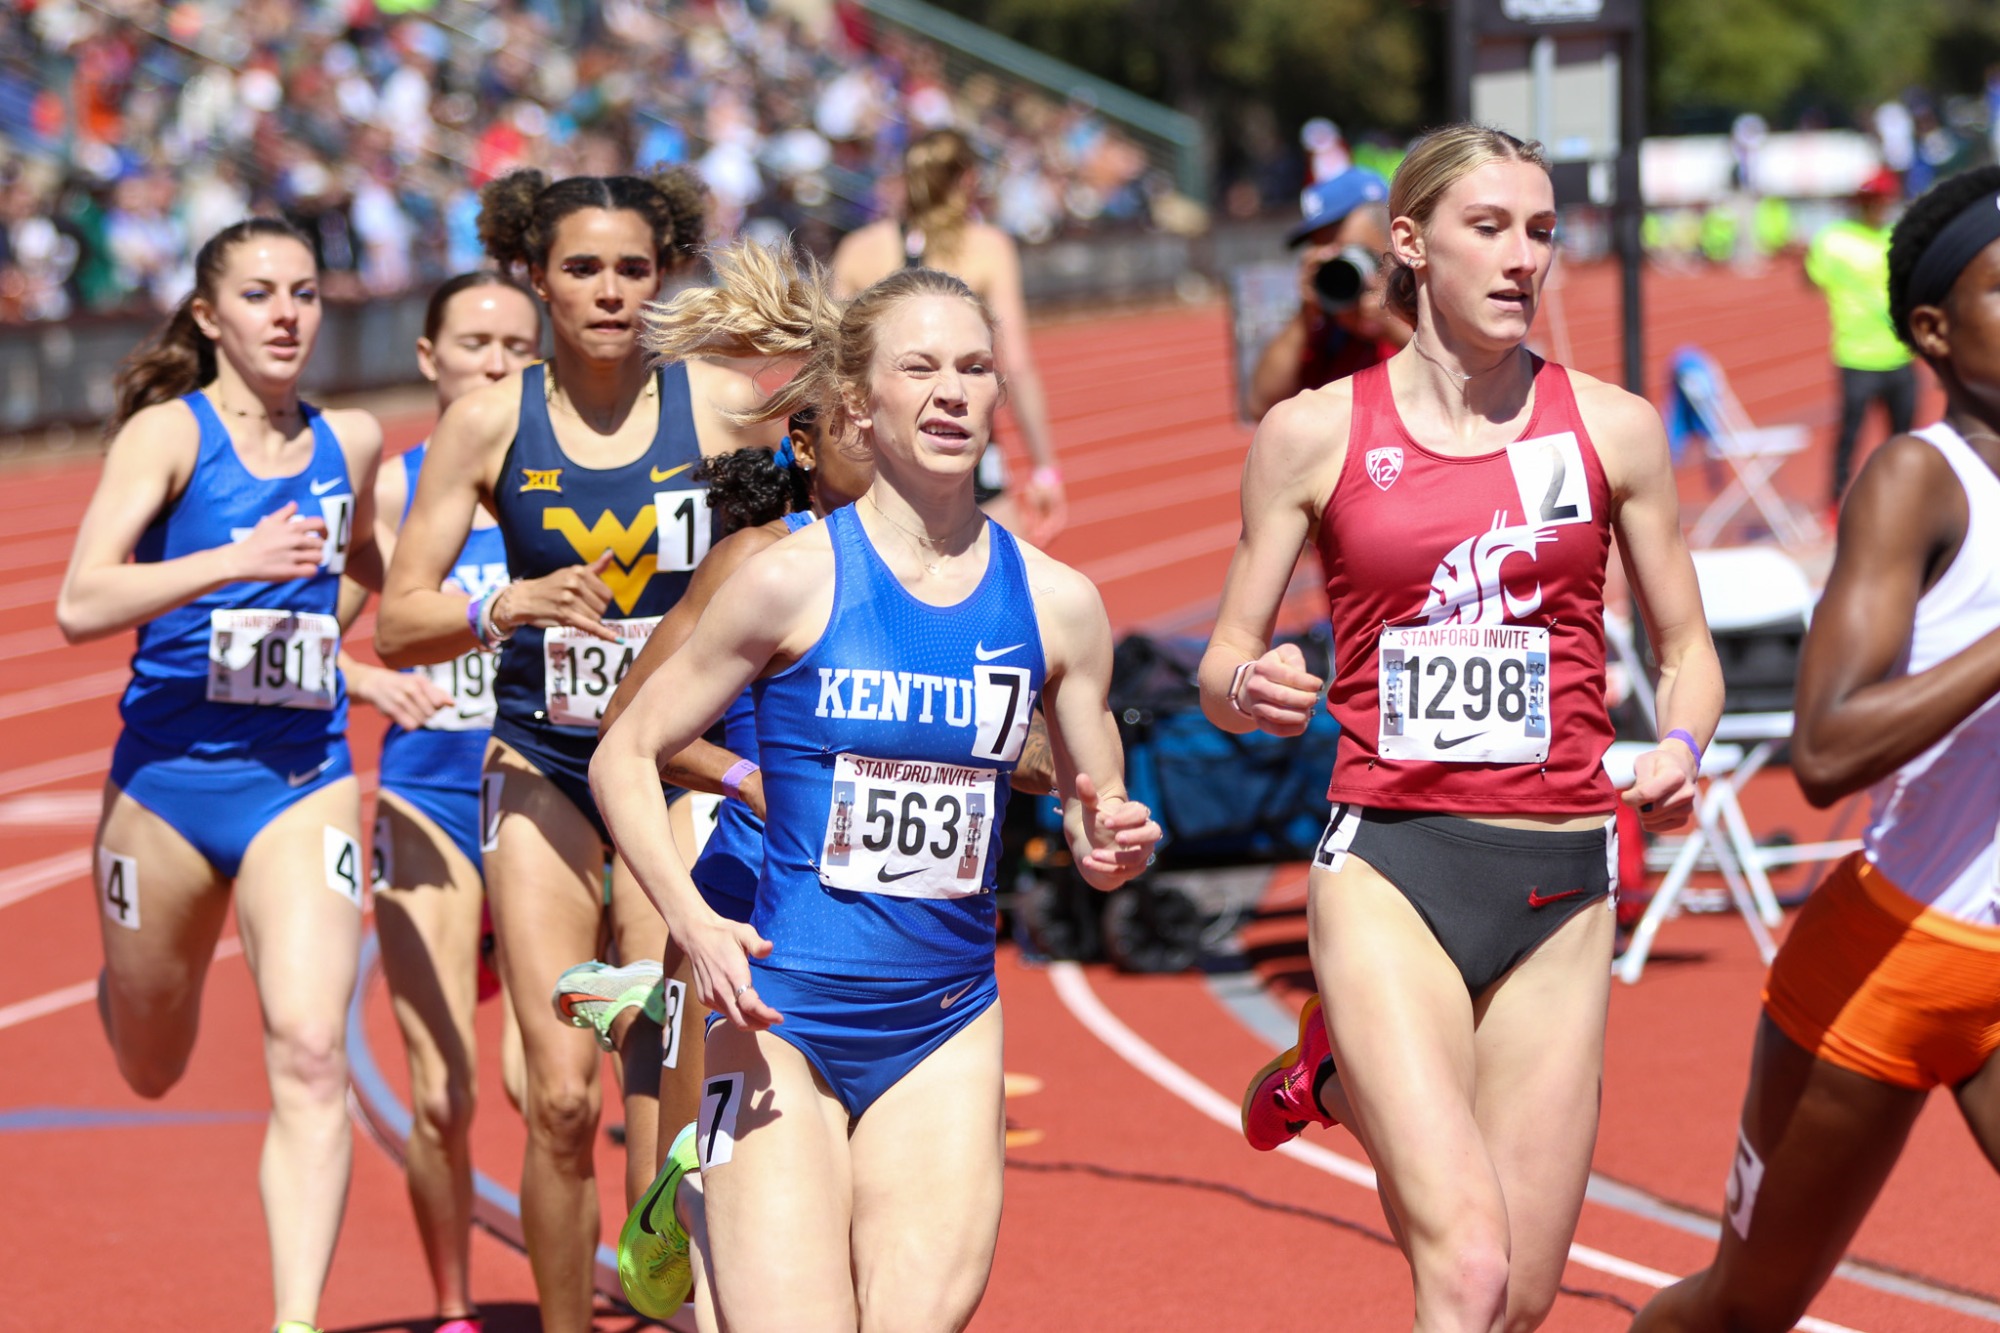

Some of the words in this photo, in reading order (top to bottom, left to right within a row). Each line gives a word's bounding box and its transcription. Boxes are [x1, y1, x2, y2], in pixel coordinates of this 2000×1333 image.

[1368, 449, 1402, 475] PAC
[1376, 465, 1395, 483] 12
[1539, 443, 1579, 523] 2
[674, 498, 695, 566] 1
[251, 637, 304, 690] 191
[1400, 629, 1480, 647] STANFORD
[1484, 629, 1530, 649] INVITE
[815, 667, 1037, 728] KENTU
[988, 672, 1021, 756] 7
[1404, 655, 1527, 723] 1298
[854, 758, 932, 785] STANFORD
[934, 768, 980, 788] INVITE
[862, 788, 962, 860] 563
[107, 860, 131, 921] 4
[336, 842, 358, 895] 4
[706, 1079, 734, 1165] 7
